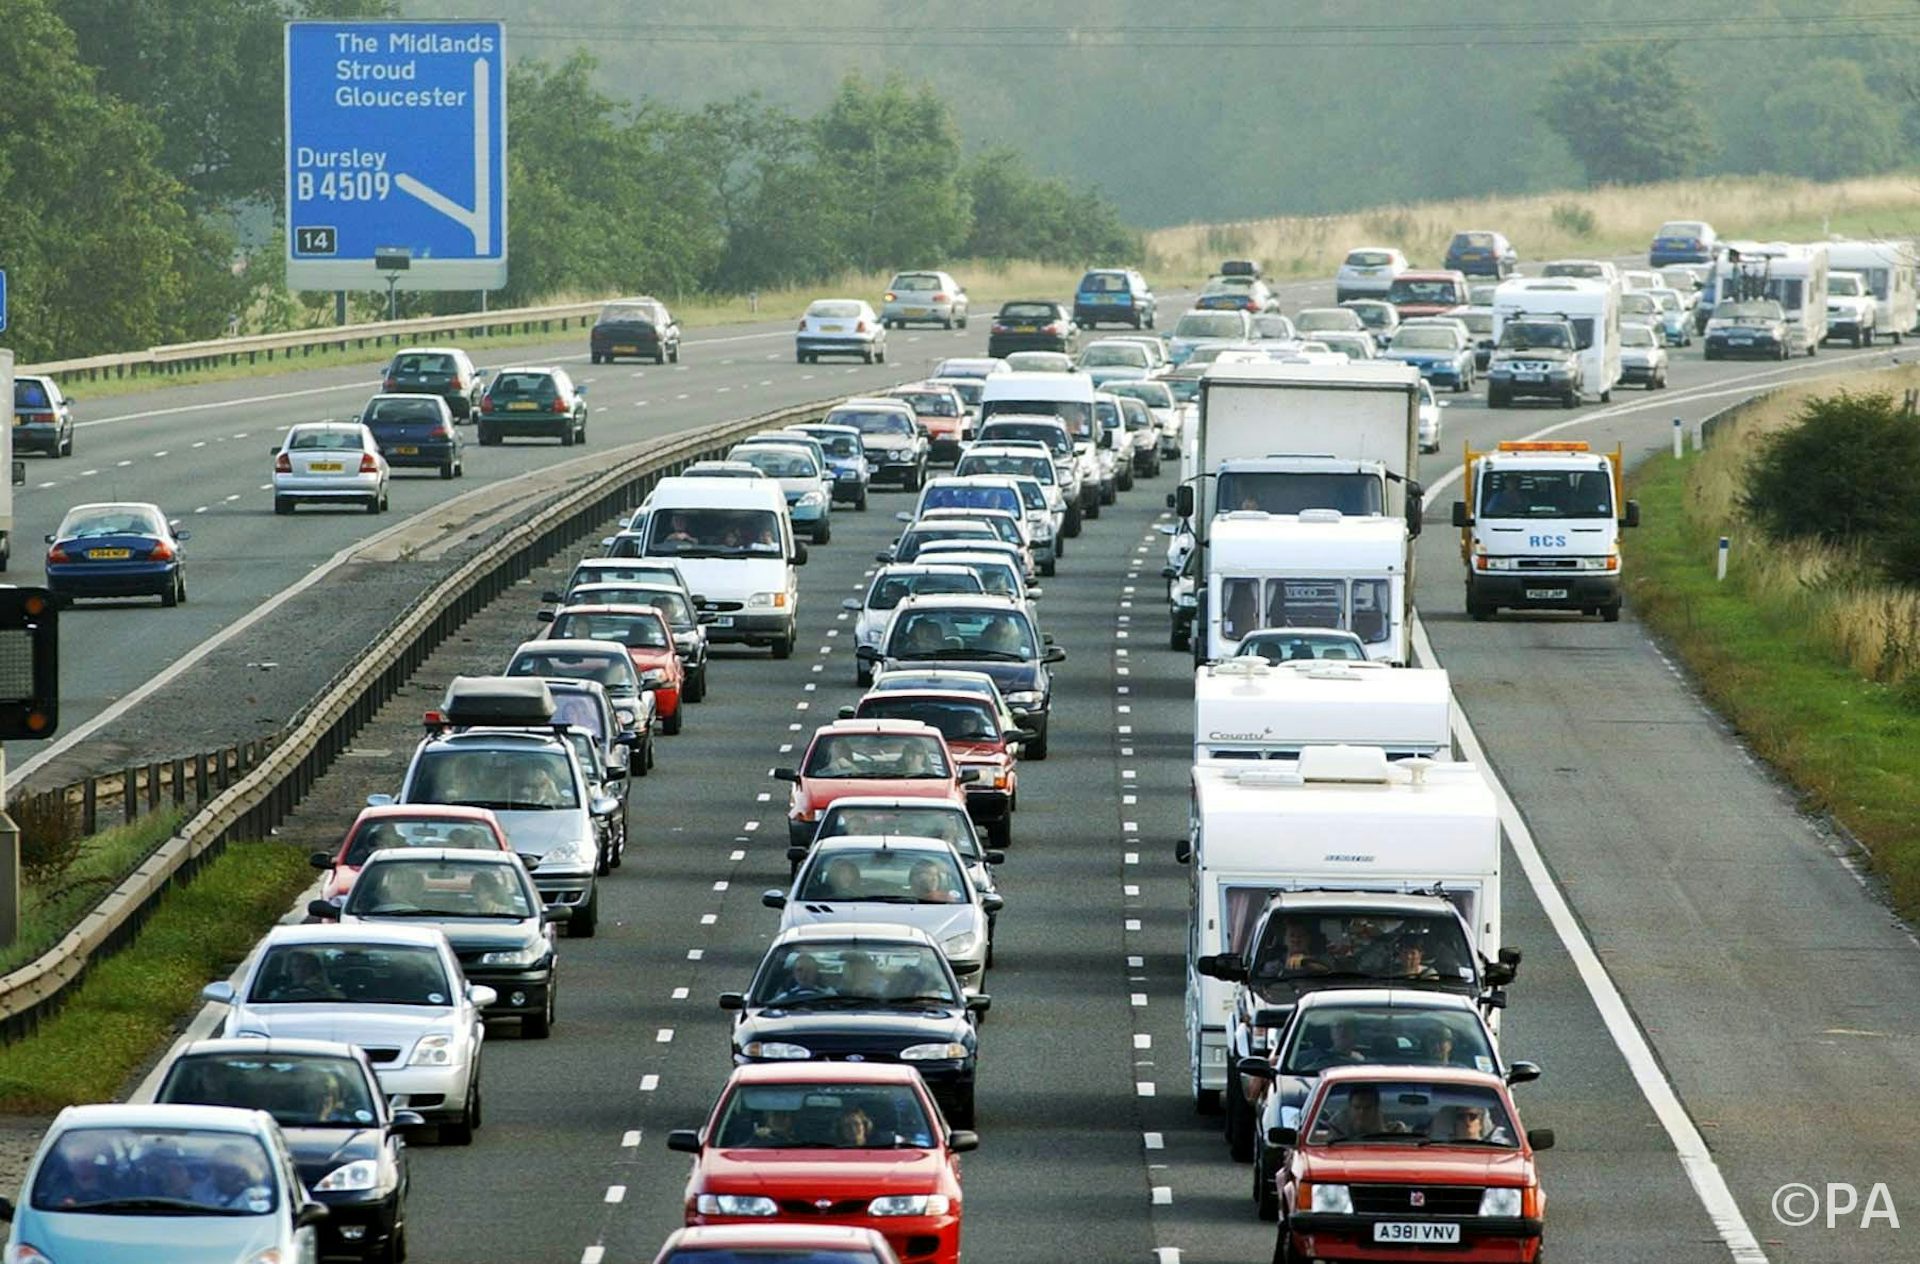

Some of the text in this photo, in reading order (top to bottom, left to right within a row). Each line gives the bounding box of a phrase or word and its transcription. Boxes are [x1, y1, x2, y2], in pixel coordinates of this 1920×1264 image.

[335, 33, 494, 53] The Midlands
[336, 59, 416, 80] Stroud
[335, 86, 467, 107] Gloucester
[297, 148, 387, 171] Dursley
[304, 231, 329, 249] 14
[1529, 535, 1567, 547] RCS
[1209, 731, 1264, 741] County
[1380, 1225, 1456, 1240] A381 VNV
